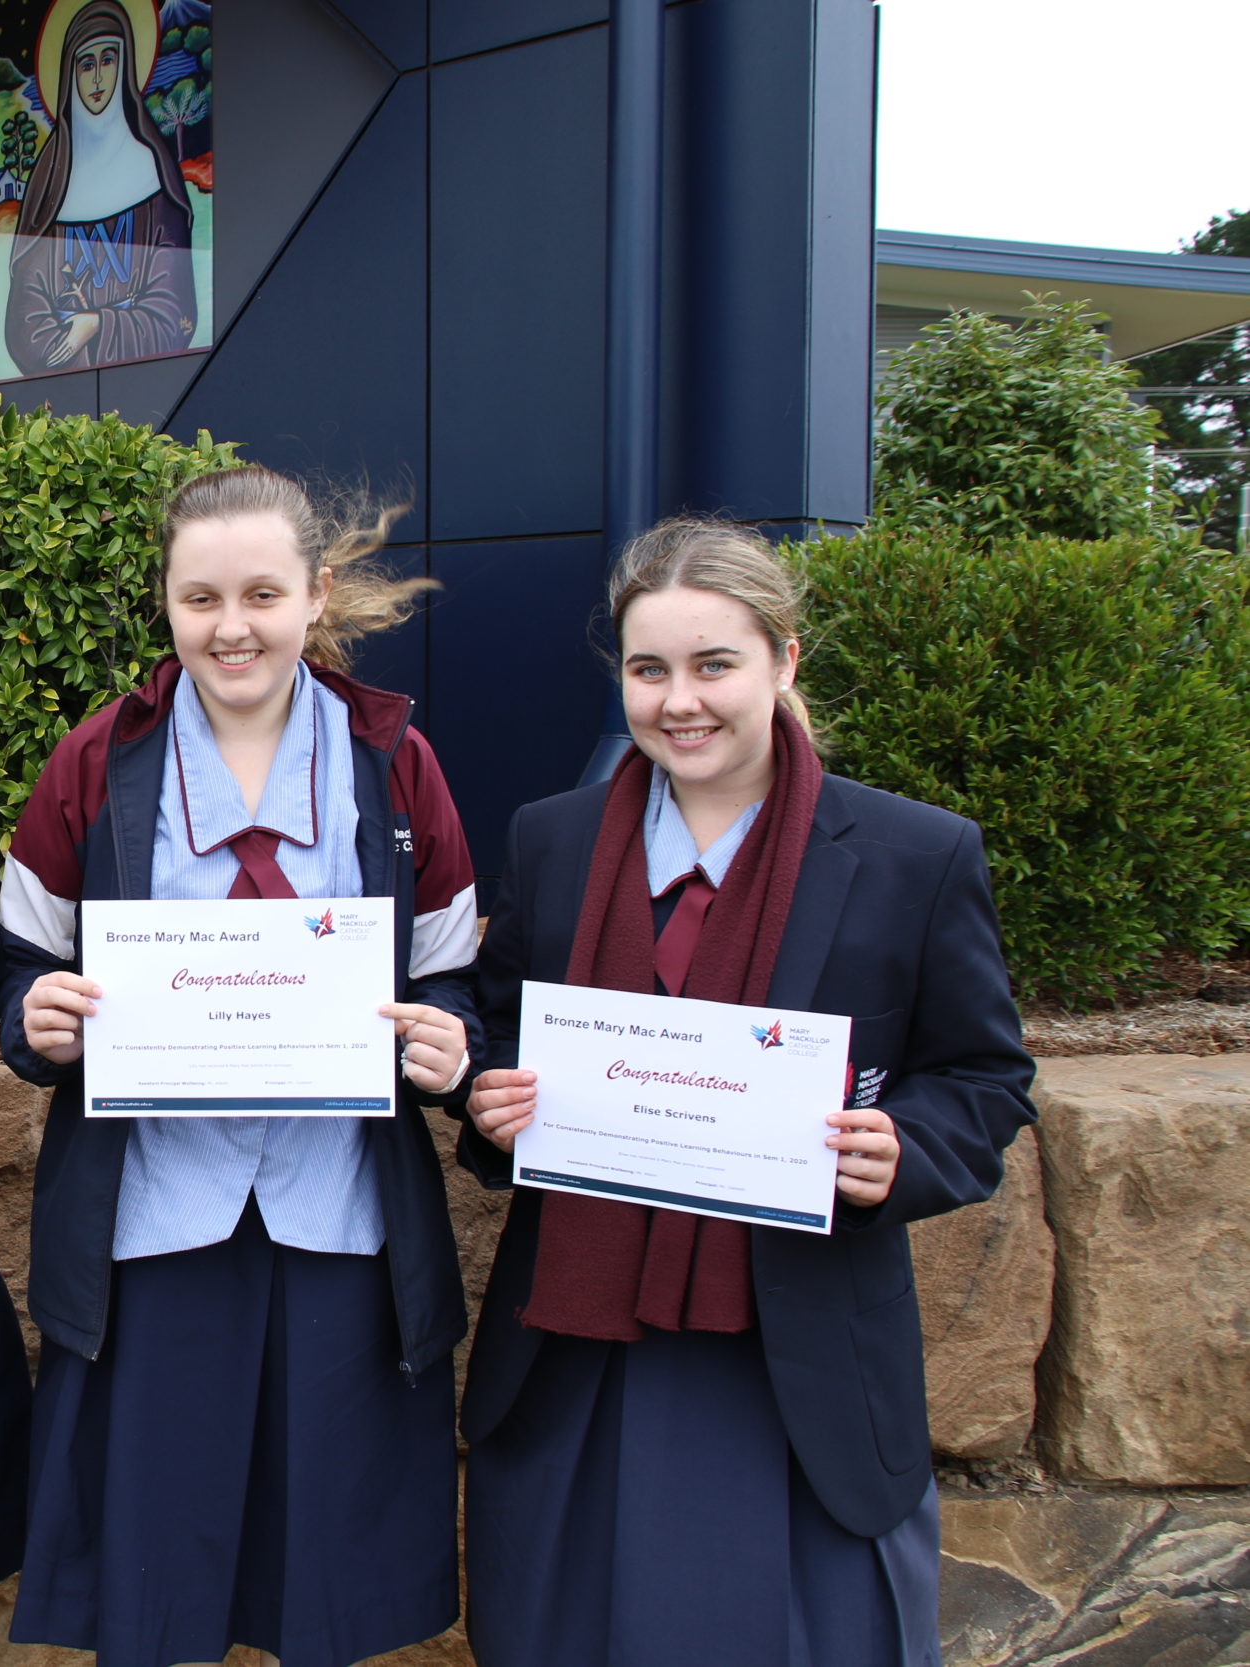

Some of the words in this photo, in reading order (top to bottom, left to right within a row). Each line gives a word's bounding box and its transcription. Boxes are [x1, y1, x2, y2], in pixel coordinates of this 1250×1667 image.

[106, 931, 151, 942] Bronze
[154, 931, 185, 944] Mary
[189, 931, 215, 942] Mac
[219, 931, 259, 942] Award
[171, 968, 305, 992] Congratulations
[208, 1011, 232, 1021] Lilly
[236, 1011, 271, 1021] Hayes
[544, 1013, 590, 1029] Bronze
[593, 1019, 625, 1036] Mary
[629, 1024, 656, 1037] Mac
[659, 1028, 702, 1043] Award
[789, 1027, 810, 1035] MARY
[787, 1040, 822, 1051] CATHOLIC
[788, 1034, 830, 1044] MACKILLOP
[786, 1048, 818, 1058] COLLEGE
[606, 1059, 747, 1093] Congratulations
[858, 1070, 888, 1090] MACKILLOP
[859, 1067, 878, 1080] MARY
[856, 1082, 882, 1100] CATHOLIC
[633, 1104, 661, 1116] Elise
[664, 1108, 716, 1123] Scrivens
[555, 1123, 596, 1136] Consistently
[598, 1130, 649, 1144] Demonstrating
[650, 1138, 678, 1147] Positive
[679, 1143, 711, 1153] Learning
[712, 1147, 752, 1158] Behaviours
[789, 1157, 808, 1165] 2020
